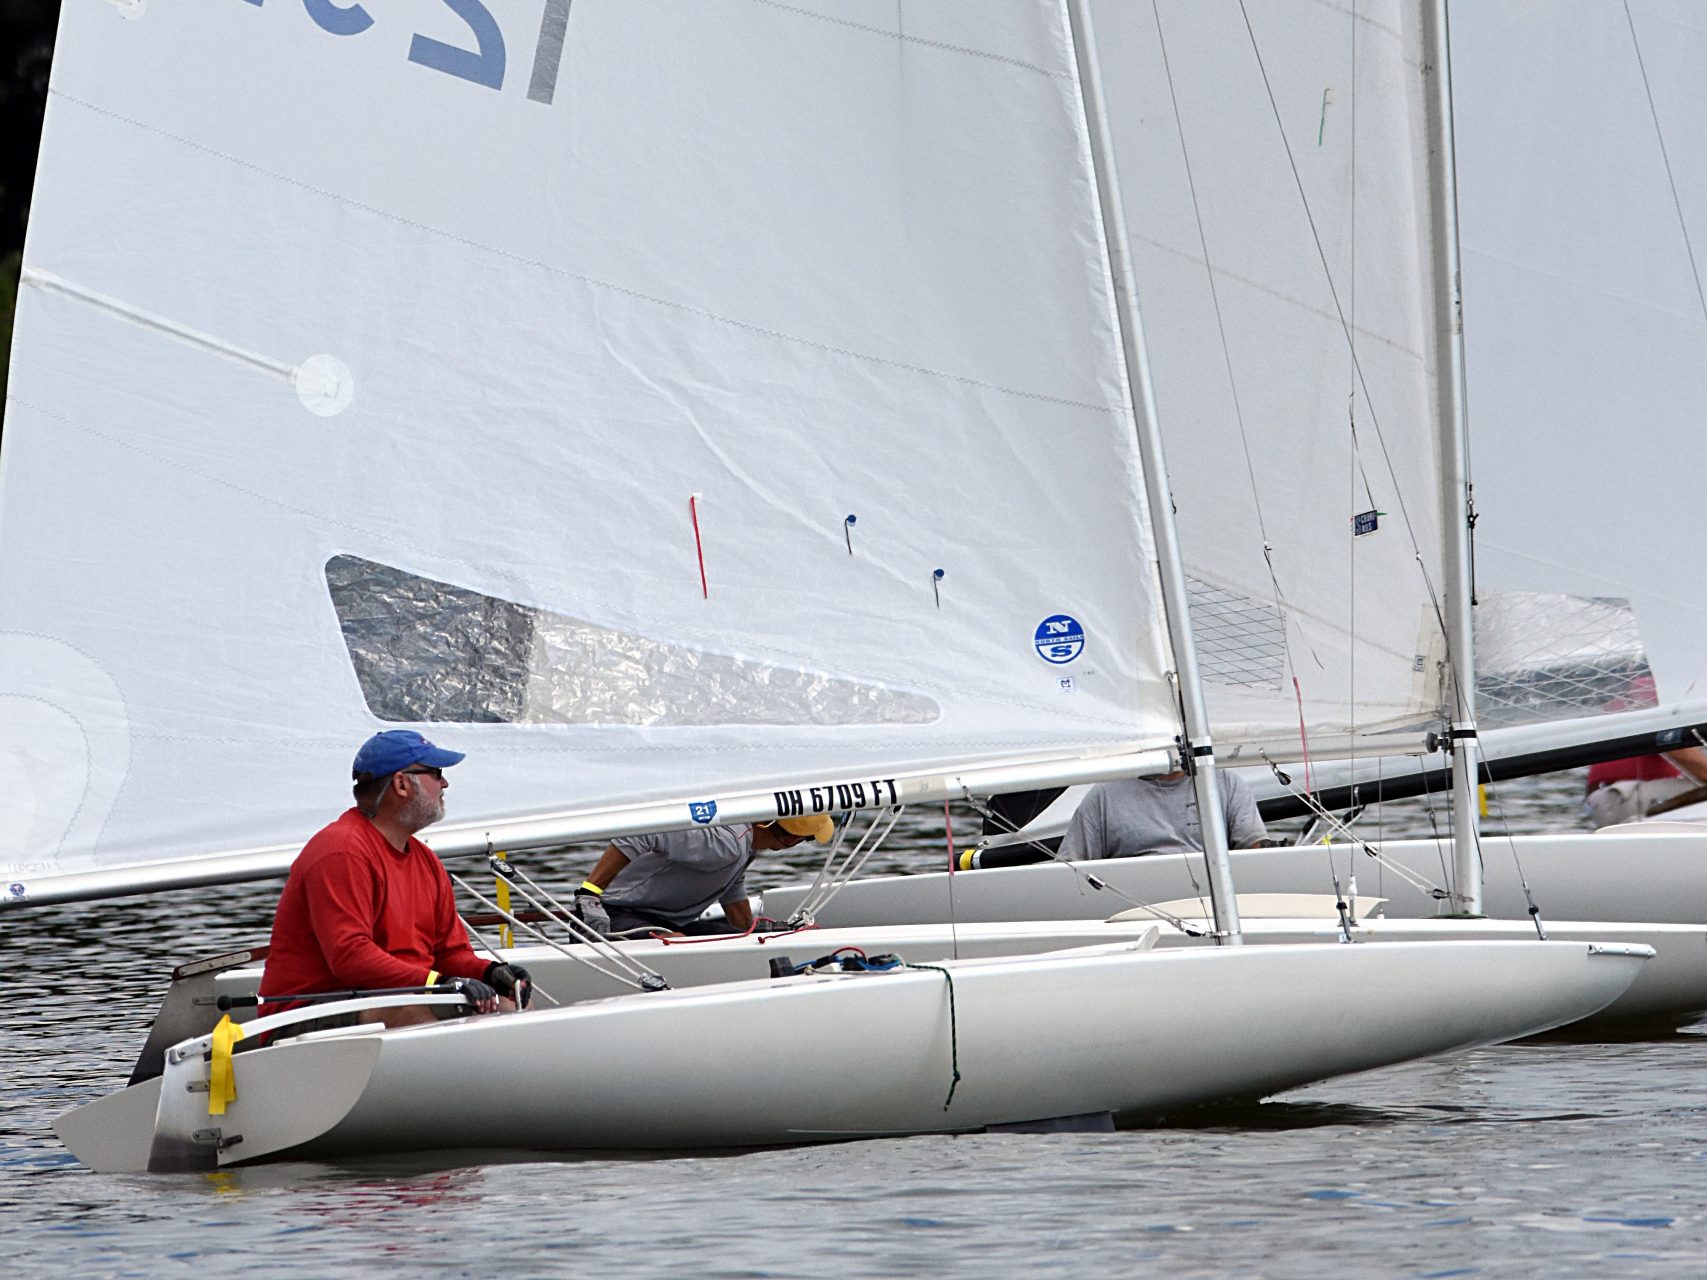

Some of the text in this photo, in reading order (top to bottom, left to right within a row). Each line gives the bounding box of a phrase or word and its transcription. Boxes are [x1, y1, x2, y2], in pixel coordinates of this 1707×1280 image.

[695, 804, 710, 816] 21
[774, 779, 898, 817] OH 6709 FT
